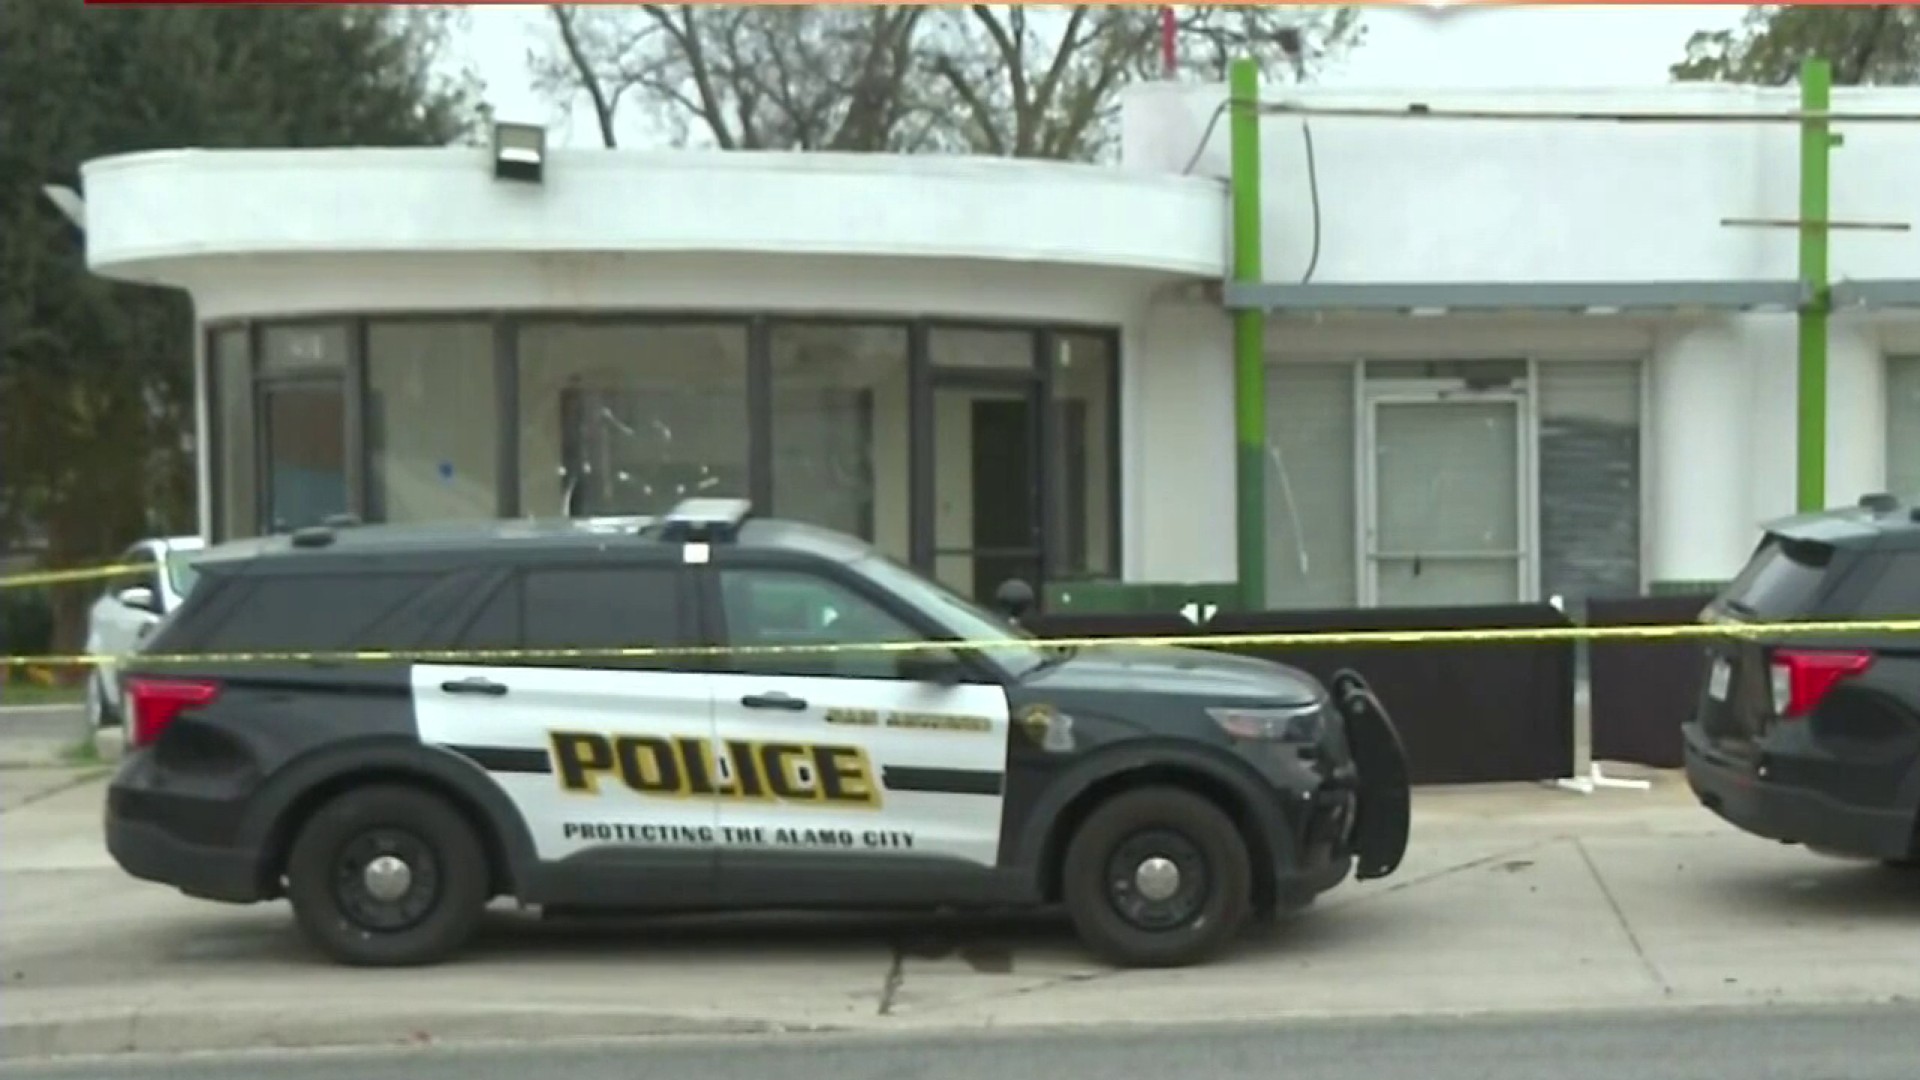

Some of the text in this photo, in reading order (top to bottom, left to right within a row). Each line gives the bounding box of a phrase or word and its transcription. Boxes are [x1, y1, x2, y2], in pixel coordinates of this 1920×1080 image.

[549, 730, 882, 810] POLICE
[562, 822, 914, 848] PROTECTING THE ALAMO CITY
